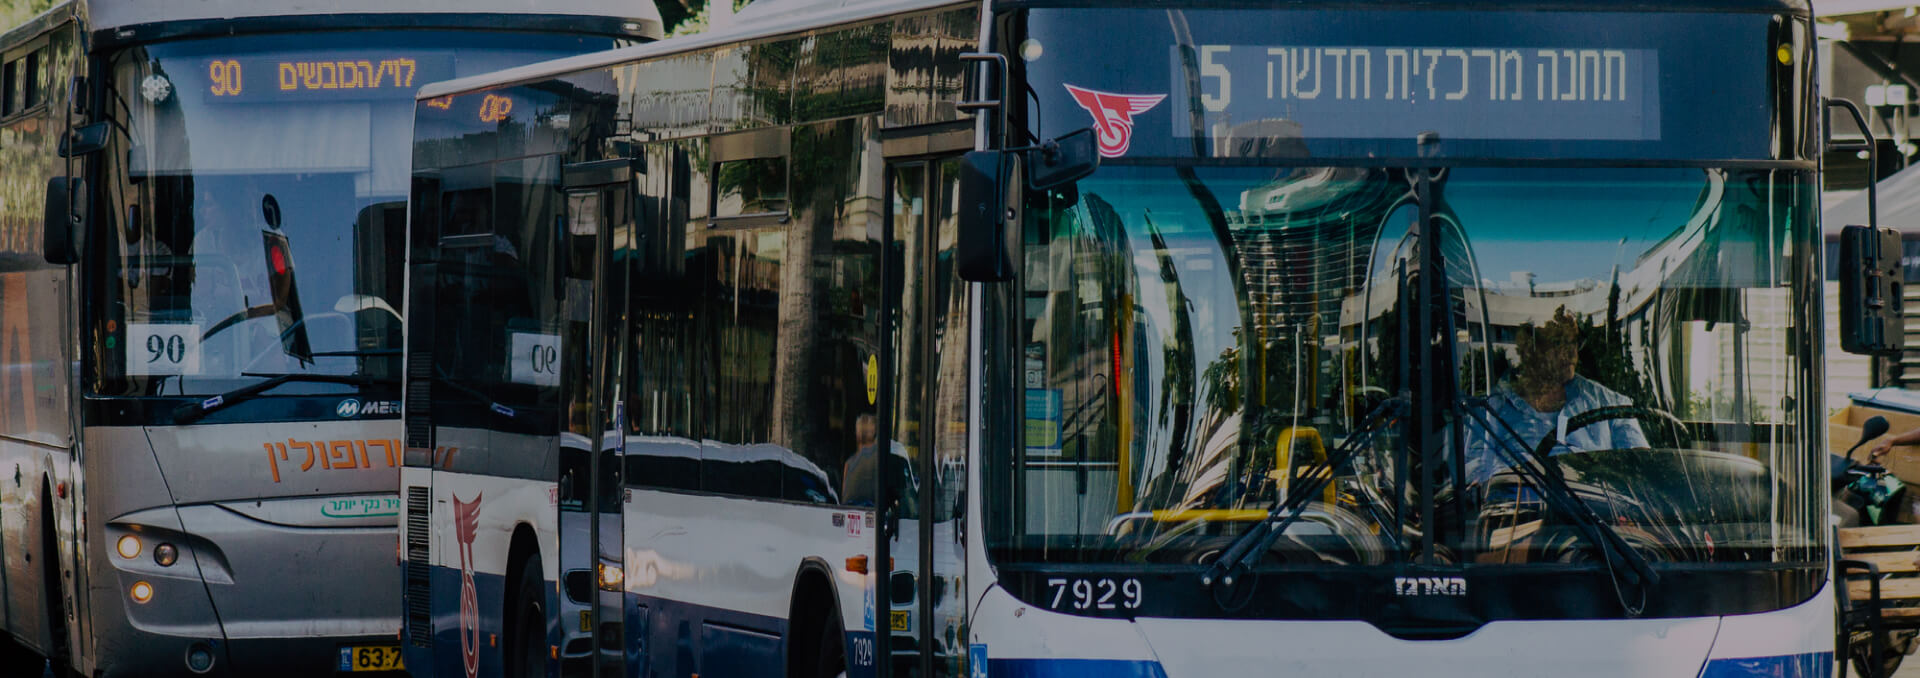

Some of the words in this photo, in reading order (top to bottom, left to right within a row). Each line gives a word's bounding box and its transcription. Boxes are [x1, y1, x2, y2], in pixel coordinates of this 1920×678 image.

[209, 59, 242, 97] 90
[1200, 45, 1231, 112] 5
[1266, 47, 1371, 100] חדשה
[1385, 48, 1523, 101] מרכזית
[1537, 49, 1626, 101] תחנה
[147, 334, 185, 364] 90
[1048, 578, 1142, 609] 7929
[1394, 576, 1466, 596] הארגז
[853, 637, 873, 666] 7929
